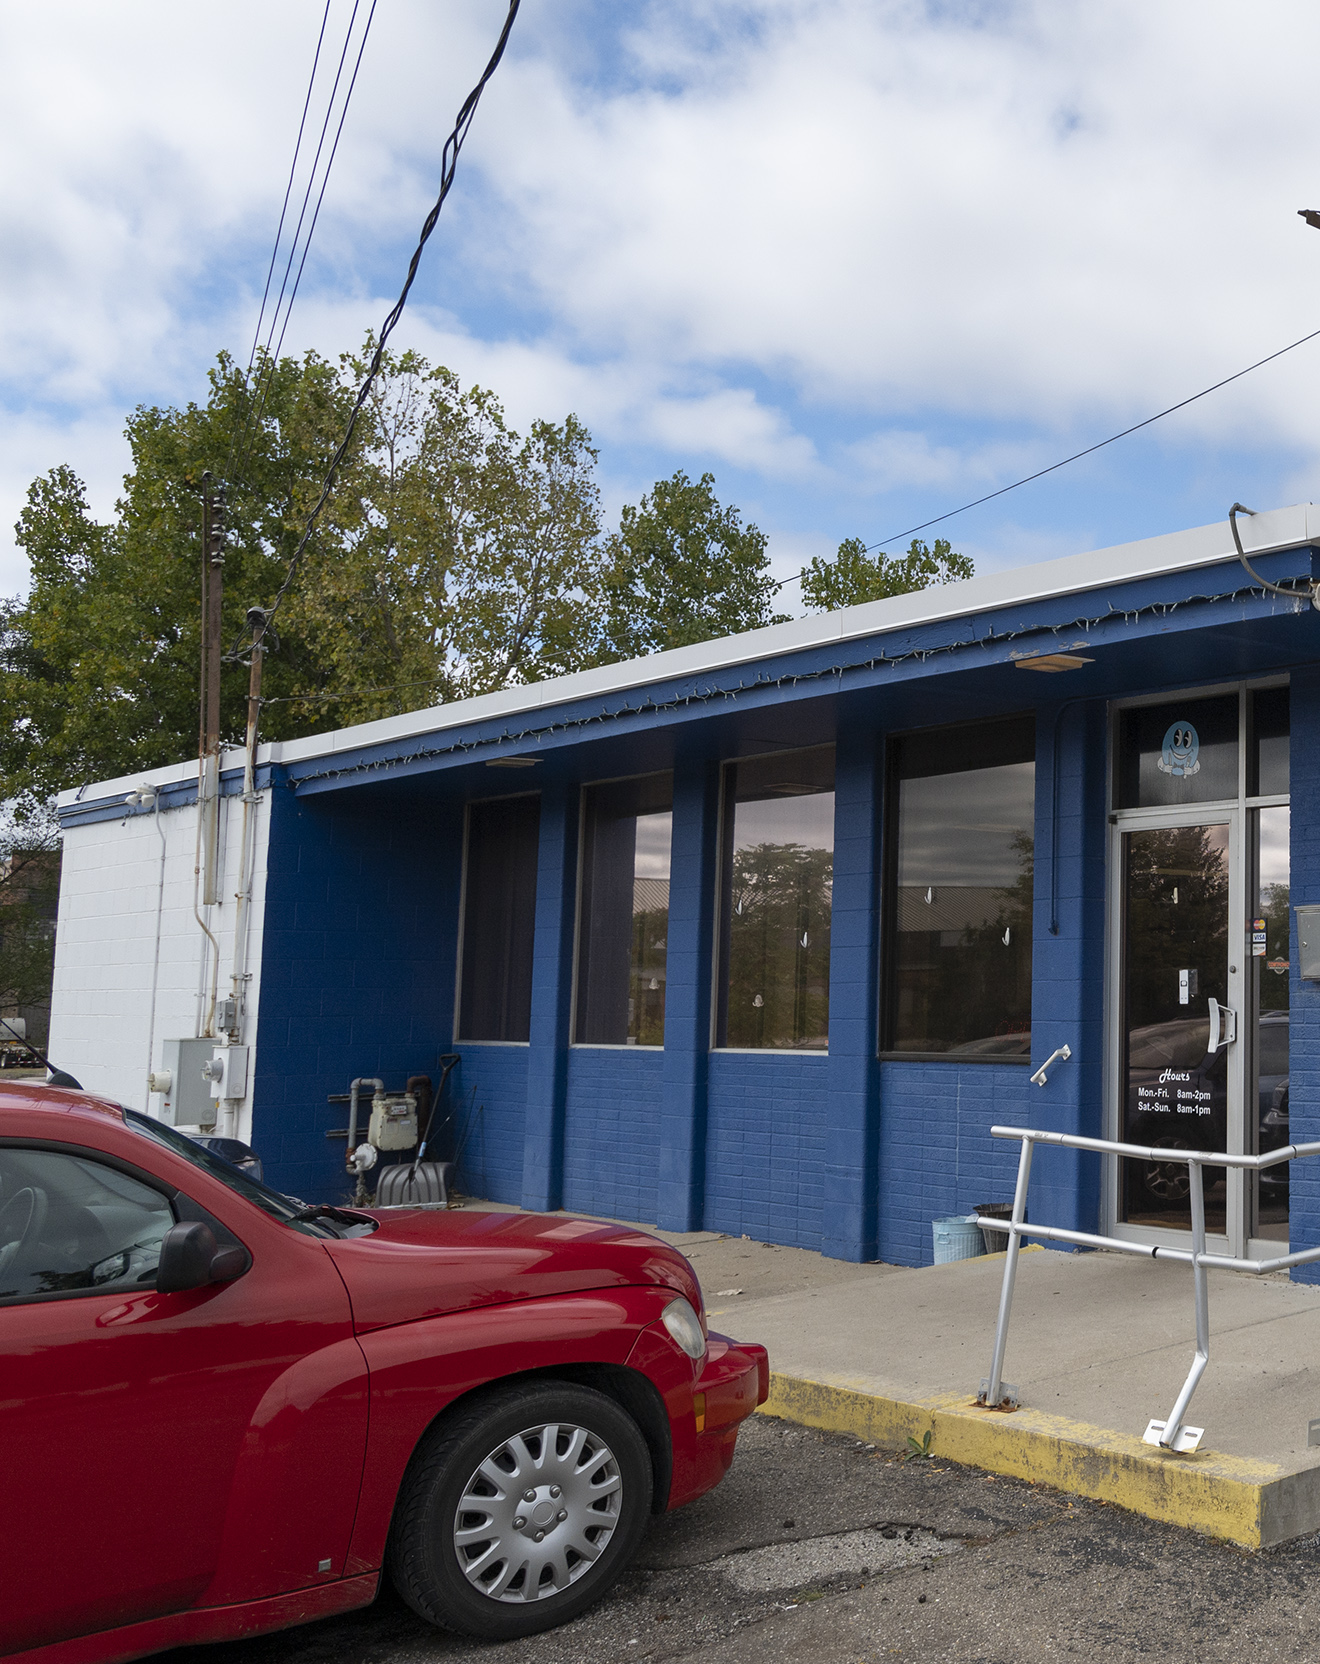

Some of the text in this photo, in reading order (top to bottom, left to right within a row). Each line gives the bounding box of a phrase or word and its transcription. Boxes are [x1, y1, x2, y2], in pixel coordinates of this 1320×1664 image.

[1159, 1068, 1190, 1084] Hours
[1176, 1089, 1211, 1102] 8am-2pm
[1176, 1104, 1211, 1116] 8am-1pm
